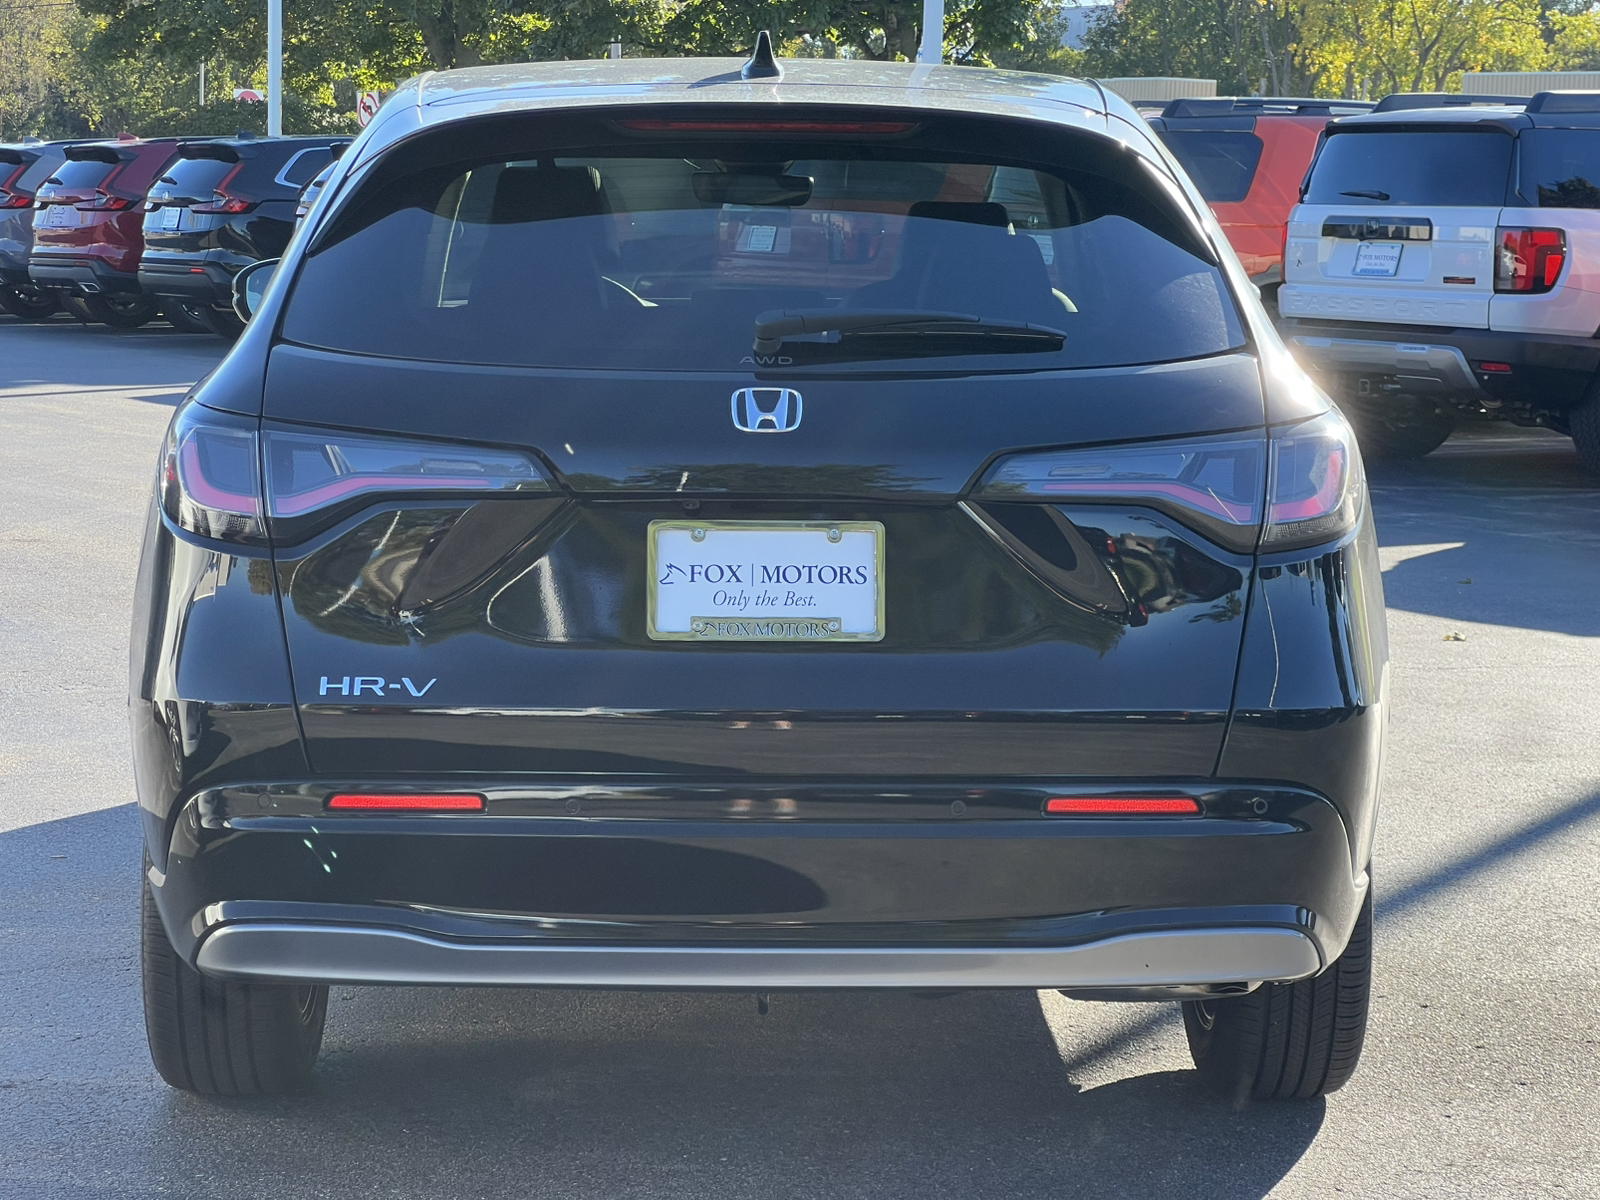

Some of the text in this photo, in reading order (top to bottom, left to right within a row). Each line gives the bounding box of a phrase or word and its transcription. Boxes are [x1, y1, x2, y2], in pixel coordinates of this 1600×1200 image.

[1289, 294, 1466, 317] PASSPORT
[739, 356, 793, 365] AWD
[688, 563, 868, 586] FOX MOTORS
[712, 589, 817, 611] Only the Best.
[717, 622, 830, 638] FOX MOTORS
[319, 676, 438, 697] HR-V
